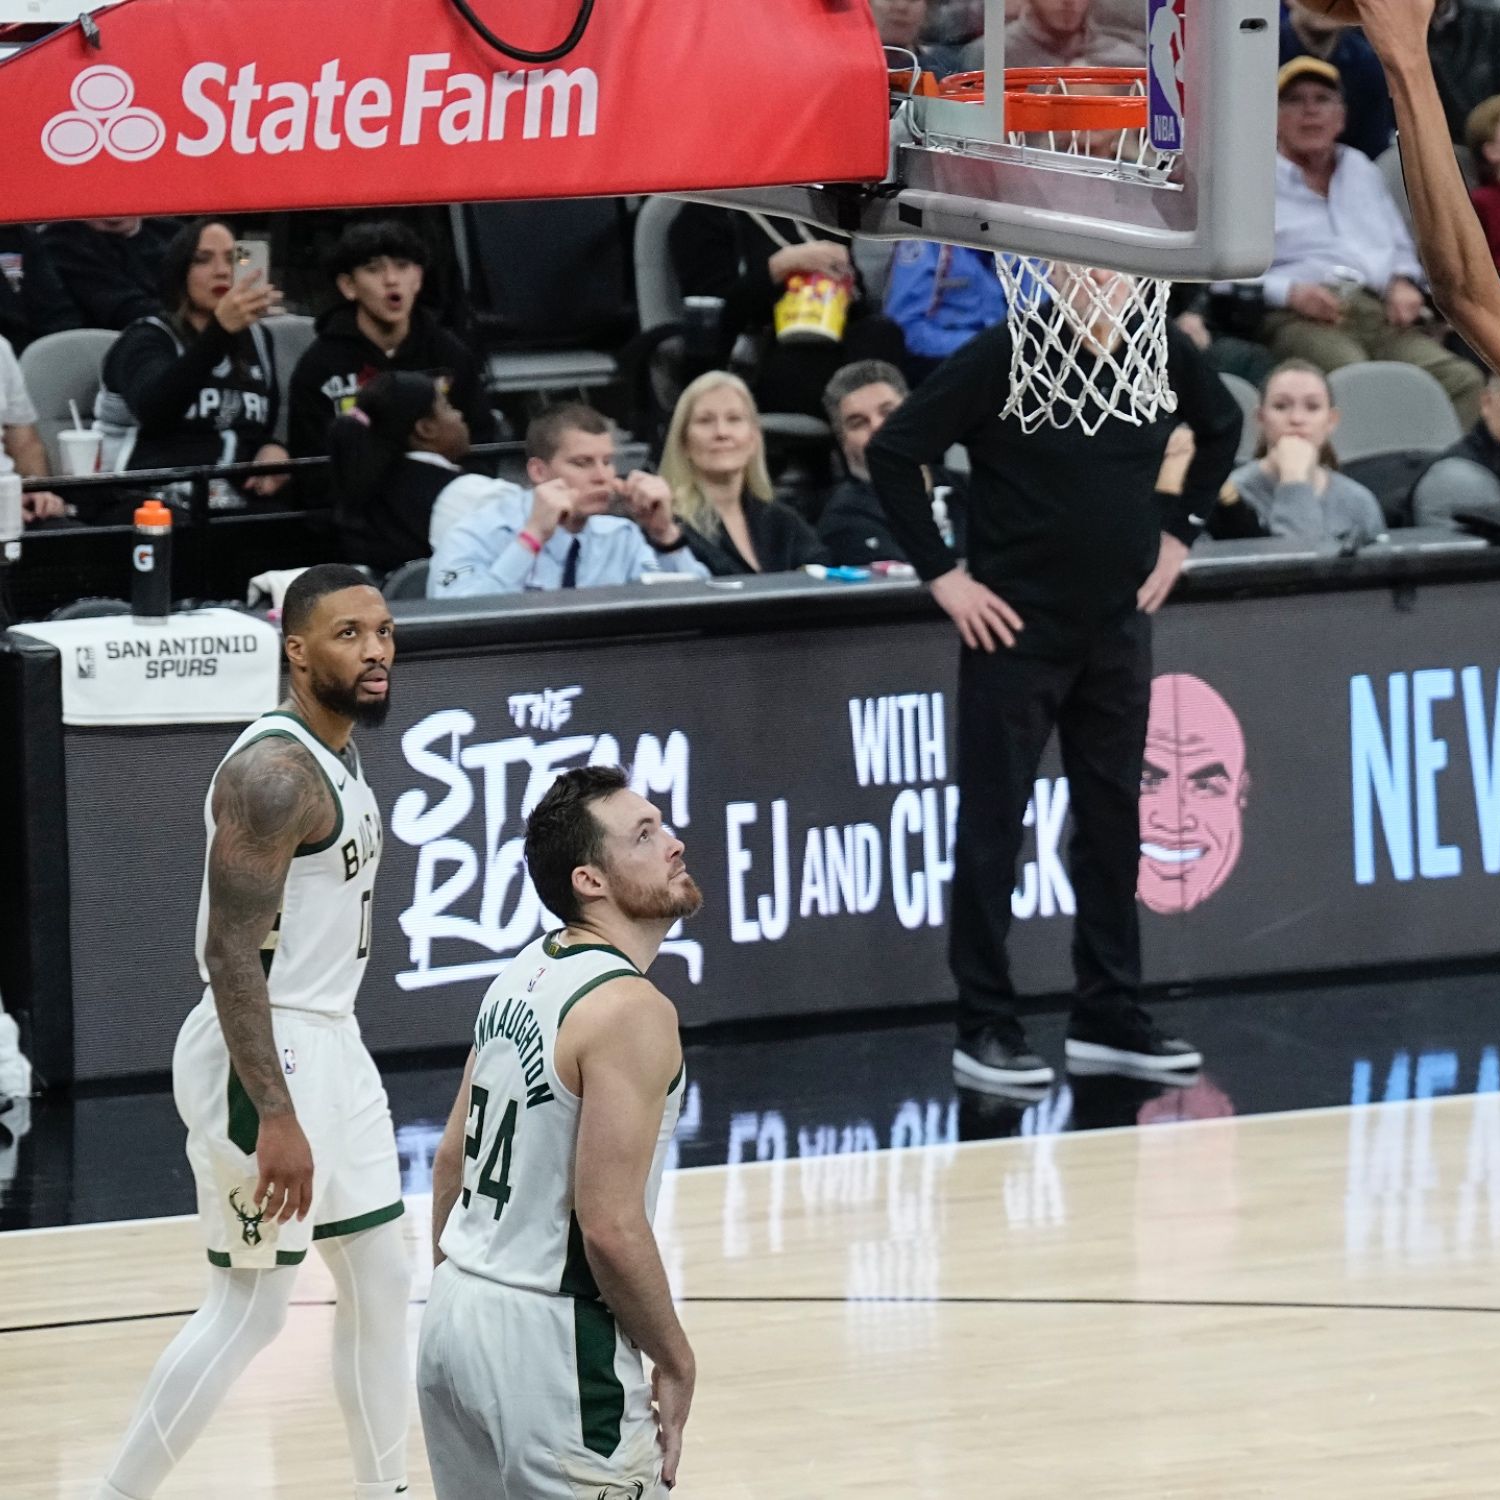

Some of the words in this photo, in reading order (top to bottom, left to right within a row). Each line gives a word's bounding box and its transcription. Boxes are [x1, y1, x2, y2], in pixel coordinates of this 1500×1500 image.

[176, 60, 392, 157] State
[399, 52, 600, 146] Farm
[1153, 113, 1177, 141] NBA
[133, 544, 154, 572] G
[106, 641, 152, 660] SAN
[158, 634, 258, 656] ANTONIO
[145, 658, 218, 680] SPURS
[507, 685, 583, 732] THE
[848, 691, 946, 787] WITH
[725, 797, 790, 944] EJ
[800, 823, 882, 918] AND
[474, 998, 555, 1109] NNAUGHTON
[462, 1084, 518, 1221] 24
